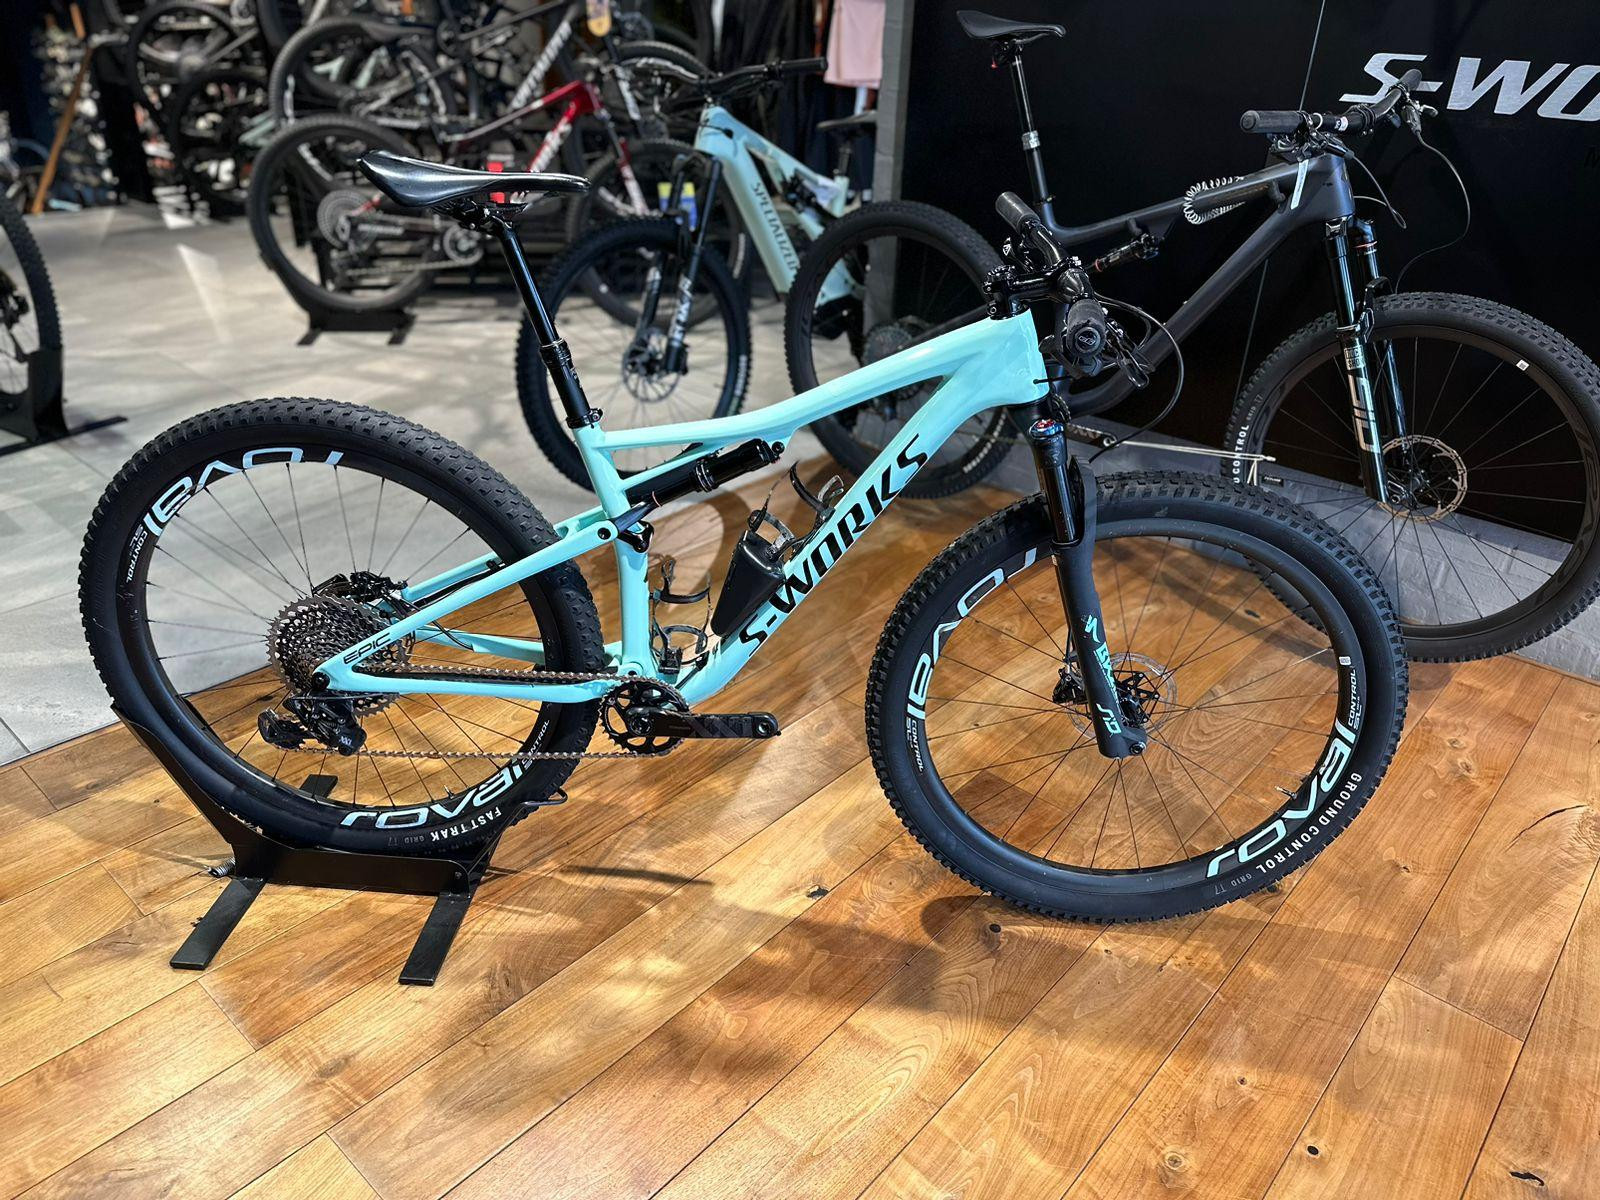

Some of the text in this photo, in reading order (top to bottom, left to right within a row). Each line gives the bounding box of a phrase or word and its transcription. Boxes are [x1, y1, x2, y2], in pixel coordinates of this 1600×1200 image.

[1232, 424, 1249, 475] COTROL
[126, 530, 148, 583] CONTROL
[739, 433, 928, 657] S-WORKS
[343, 632, 391, 664] EPIC
[1348, 669, 1358, 727] CONTROL
[521, 719, 550, 765] CNTROL
[911, 719, 924, 773] CONTROL
[1319, 772, 1362, 826] GROUND
[1256, 823, 1320, 873] CONTROL
[1230, 873, 1252, 887] GRID
